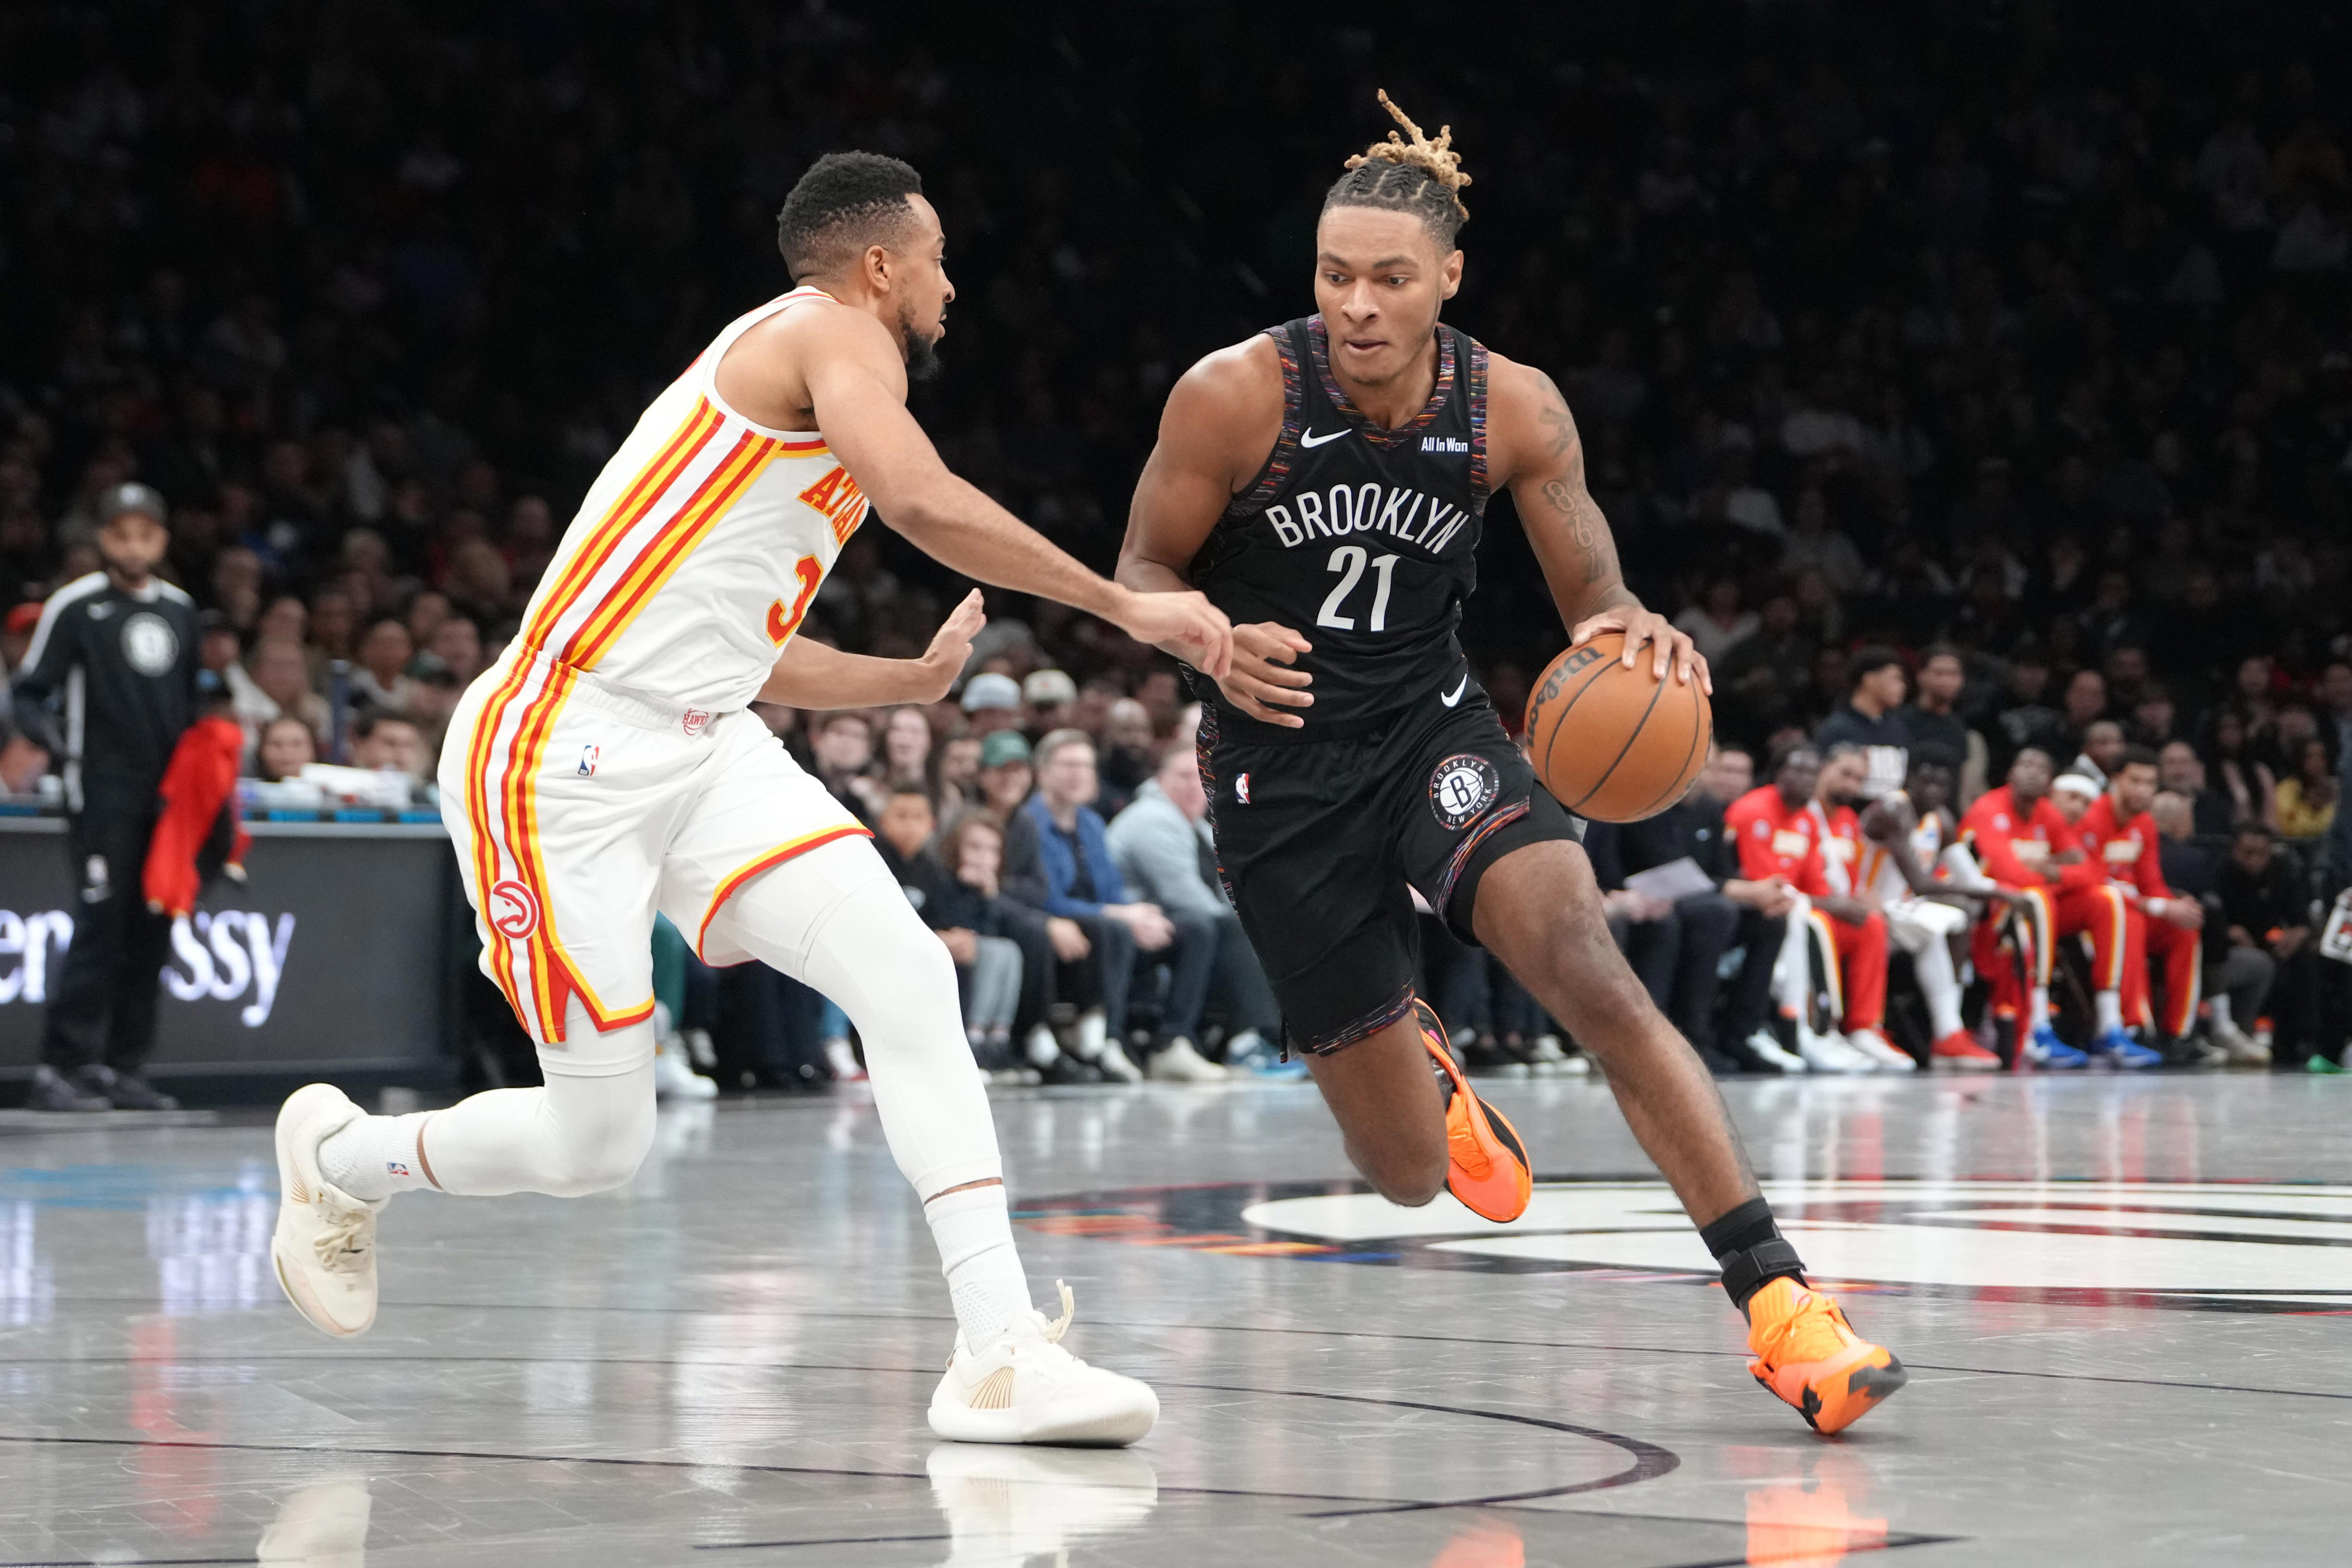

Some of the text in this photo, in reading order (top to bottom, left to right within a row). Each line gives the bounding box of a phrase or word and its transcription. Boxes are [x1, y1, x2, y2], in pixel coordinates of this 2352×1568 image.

[1421, 437, 1468, 452] All In Won
[1265, 482, 1469, 555] BROOKLYN
[766, 553, 824, 650] 3
[1317, 546, 1400, 632] 21
[1433, 759, 1485, 799] BROOKLYN
[1450, 775, 1472, 809] B
[1447, 788, 1492, 825] NEW YORK
